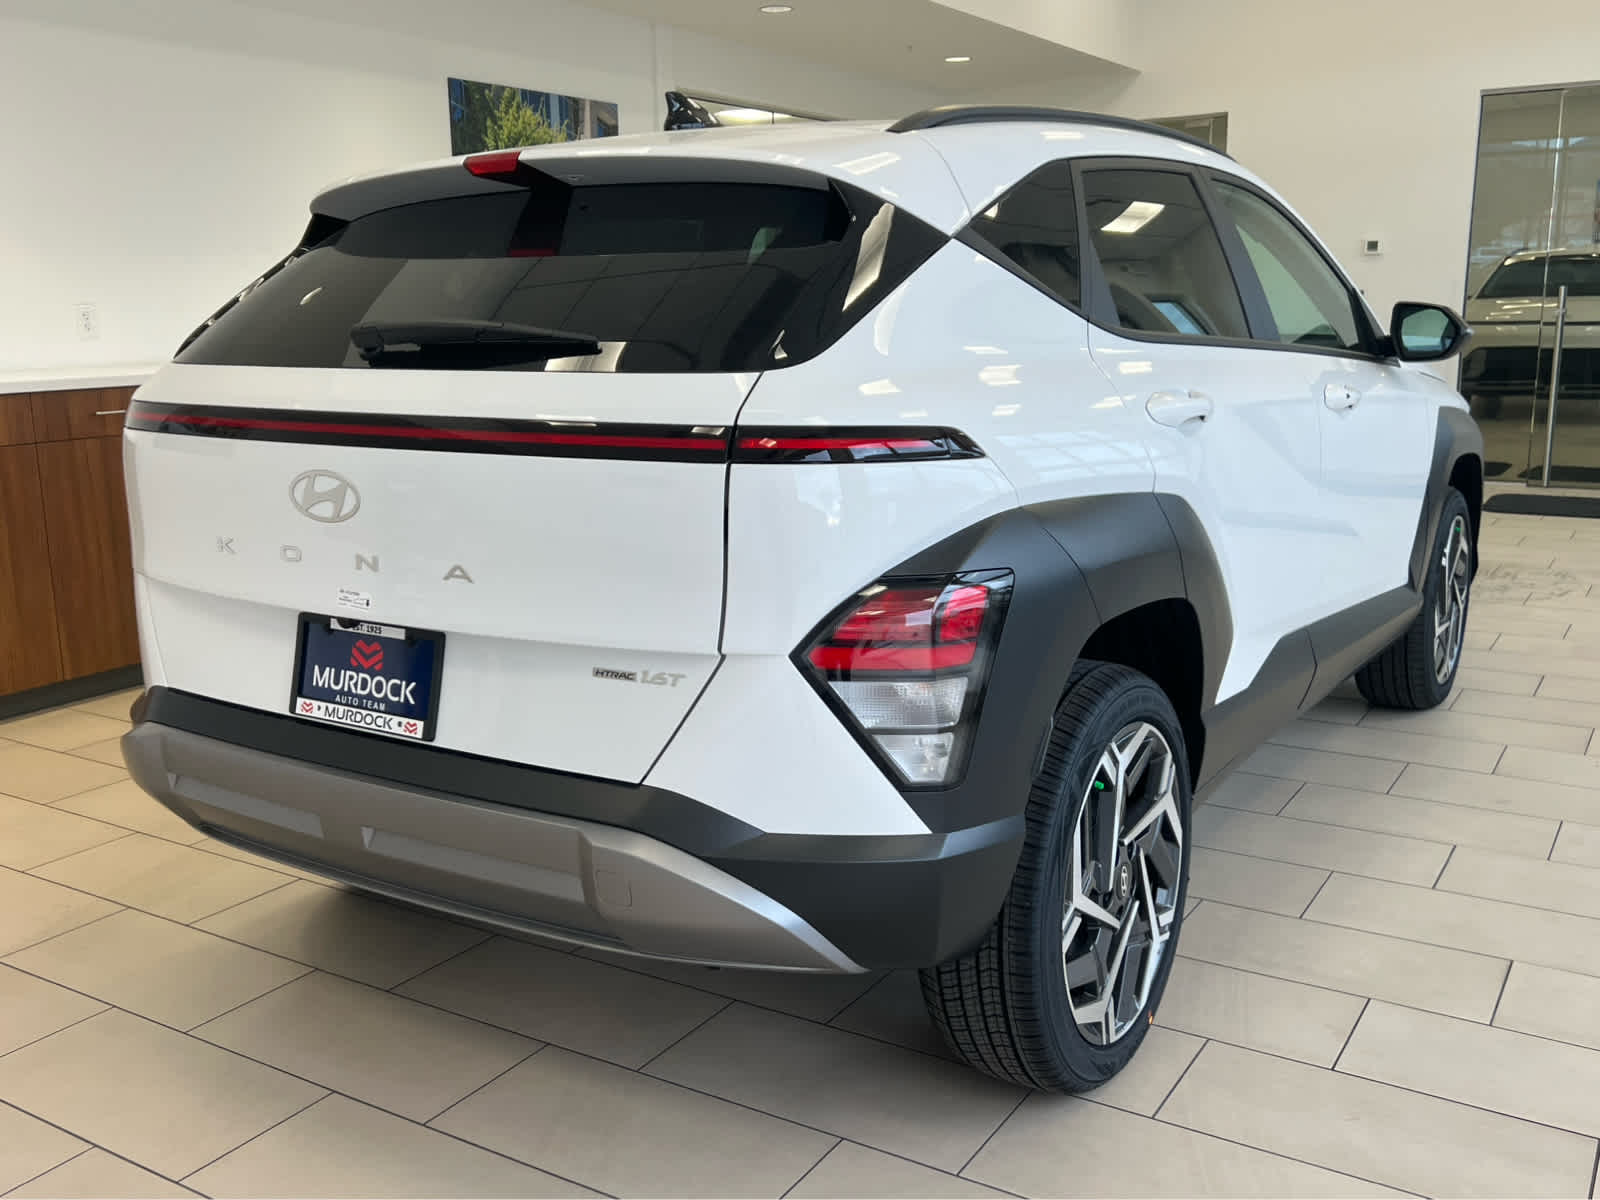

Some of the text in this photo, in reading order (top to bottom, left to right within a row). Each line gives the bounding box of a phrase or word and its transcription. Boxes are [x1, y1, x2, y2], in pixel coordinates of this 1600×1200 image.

[215, 535, 475, 584] KONA
[366, 624, 383, 635] 1925
[312, 664, 417, 705] MURDOCK
[594, 668, 636, 681] HTRAC
[335, 694, 386, 711] AUTO TEAM
[323, 705, 393, 730] MURDOCK
